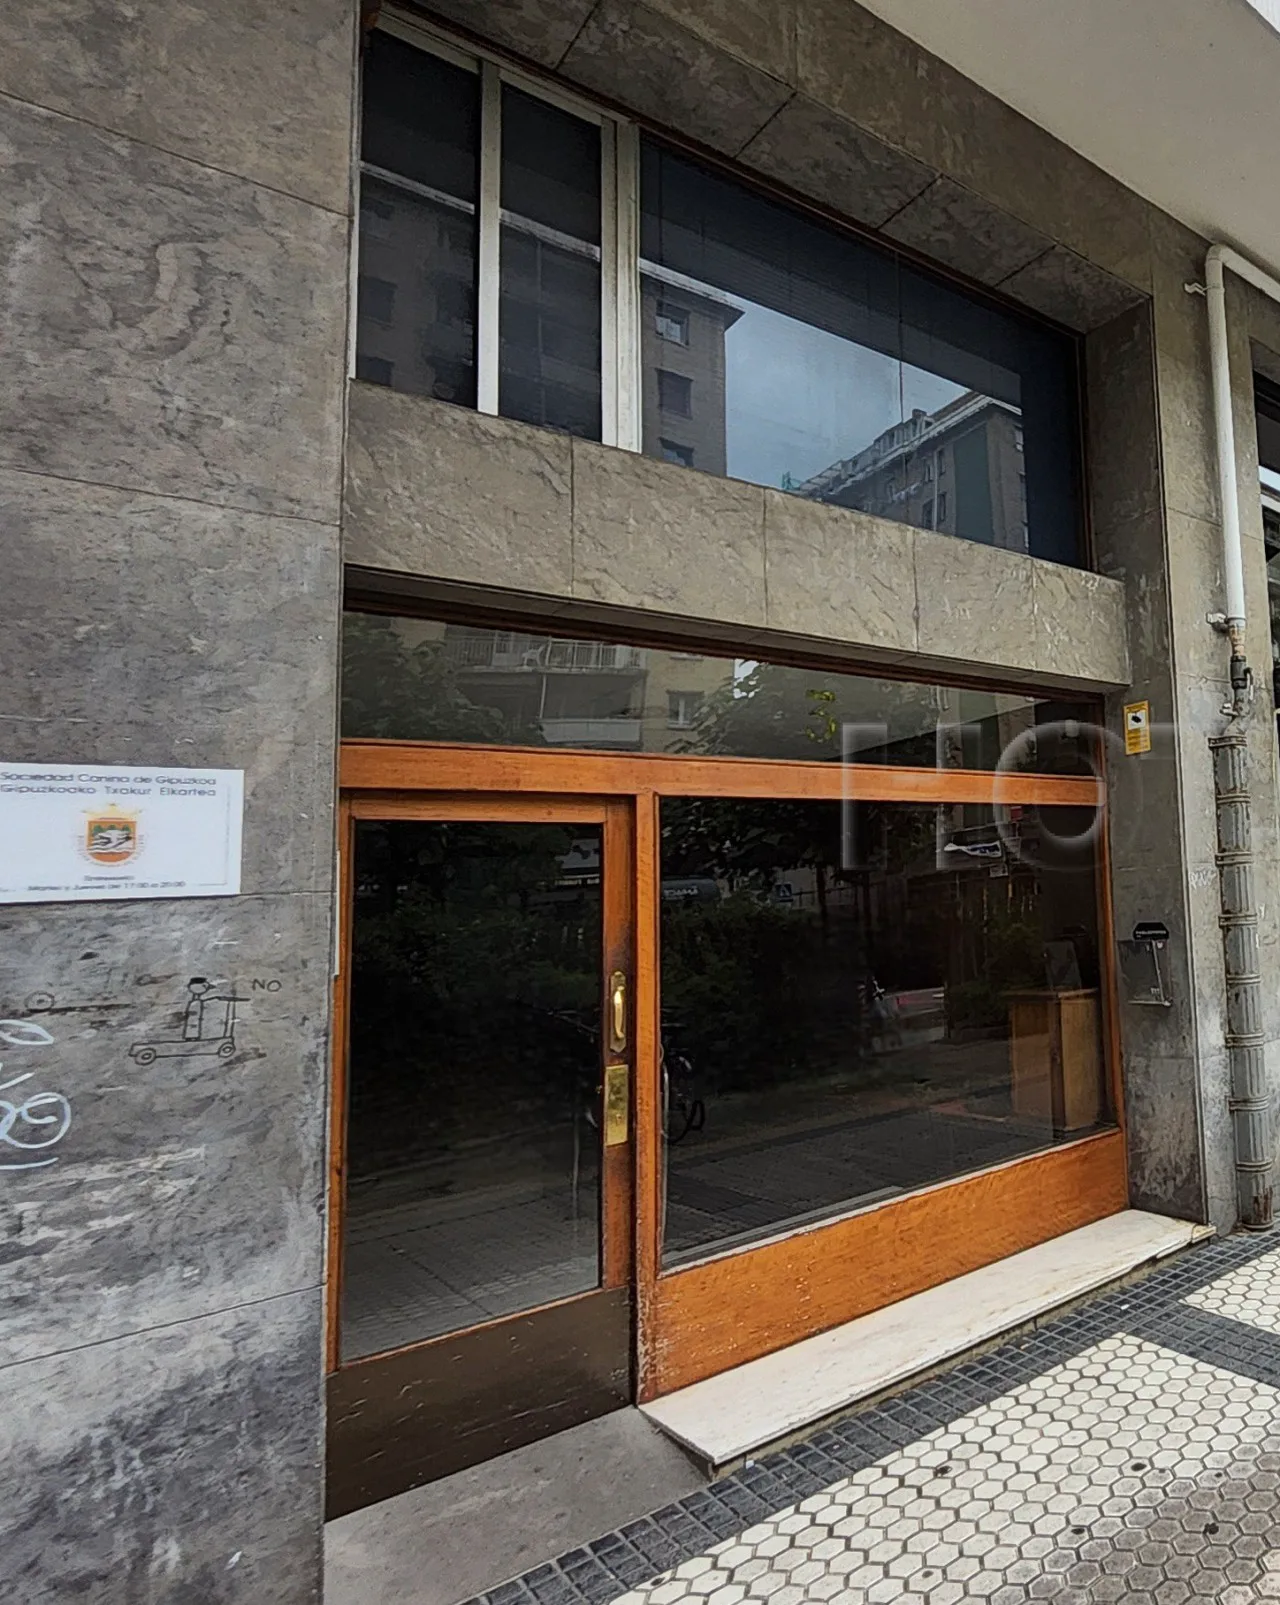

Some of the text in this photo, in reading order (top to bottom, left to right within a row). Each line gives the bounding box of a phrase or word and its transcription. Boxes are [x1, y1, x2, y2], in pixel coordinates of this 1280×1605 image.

[0, 771, 216, 786] Sociedad Canina de Gipuzkoa
[0, 785, 217, 796] Gipuzkoako Txakur Elkartea
[252, 978, 282, 992] NO
